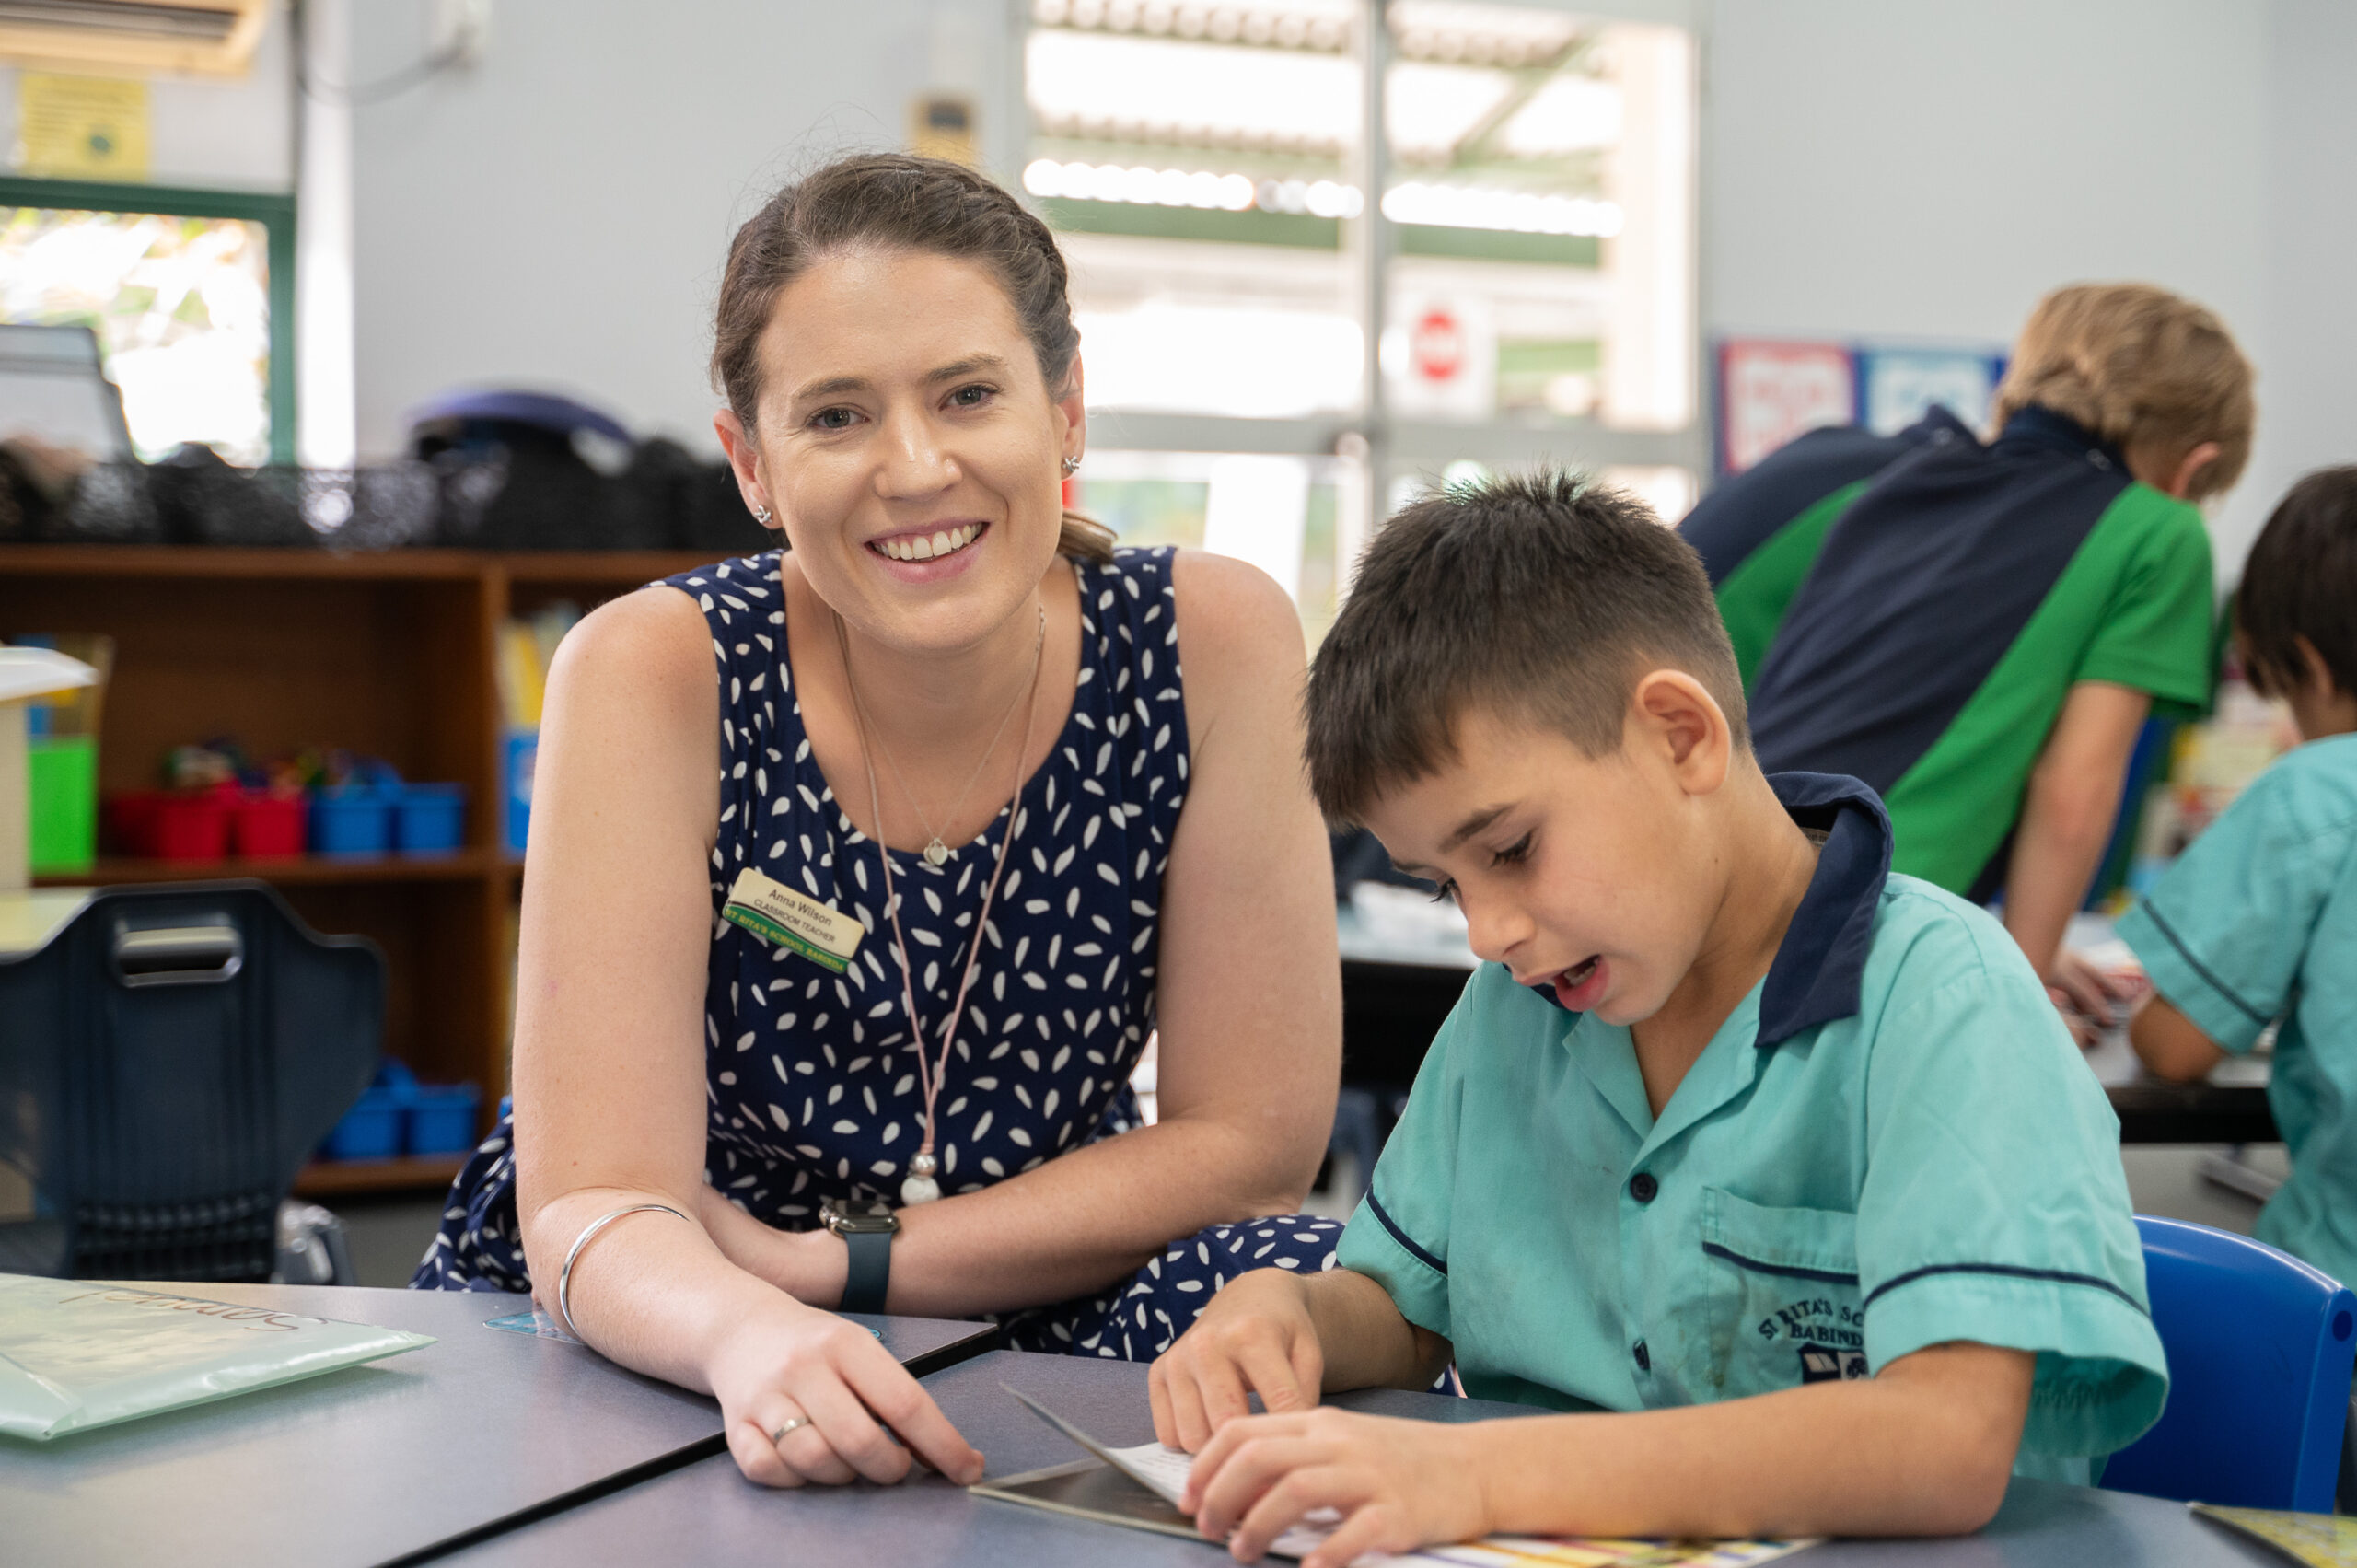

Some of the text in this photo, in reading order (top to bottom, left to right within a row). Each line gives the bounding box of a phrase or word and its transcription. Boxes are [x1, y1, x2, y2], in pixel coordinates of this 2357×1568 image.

[753, 899, 836, 943] CLASSROOM TEACHER
[769, 889, 832, 926] Anna Wilson
[769, 929, 804, 953] SCHOOL
[1758, 1318, 1779, 1340] ST
[1775, 1298, 1833, 1324] RITA'S
[1790, 1323, 1864, 1347] BABIND
